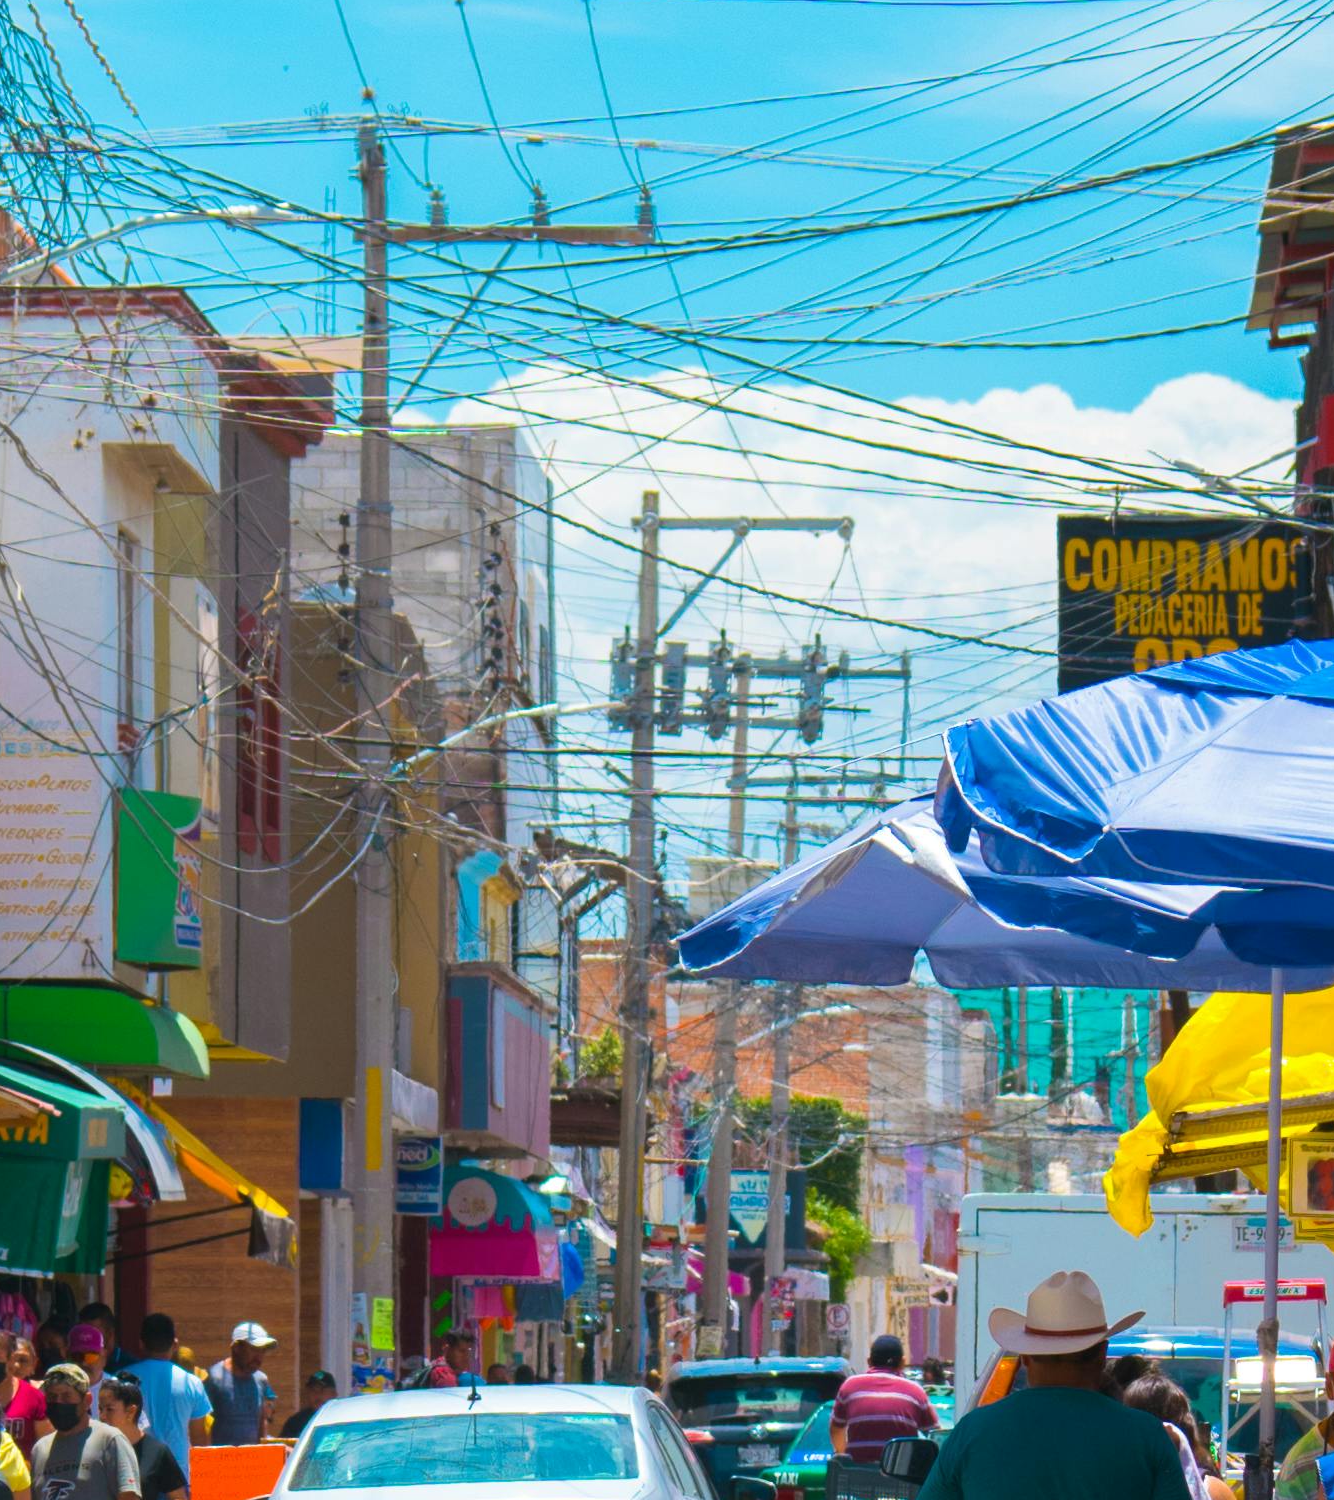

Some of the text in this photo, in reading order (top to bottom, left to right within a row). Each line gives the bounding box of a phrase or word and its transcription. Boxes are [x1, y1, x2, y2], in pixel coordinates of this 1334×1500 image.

[1115, 592, 1264, 636] PEDACERIA DE
[774, 1472, 799, 1485] TAXI
